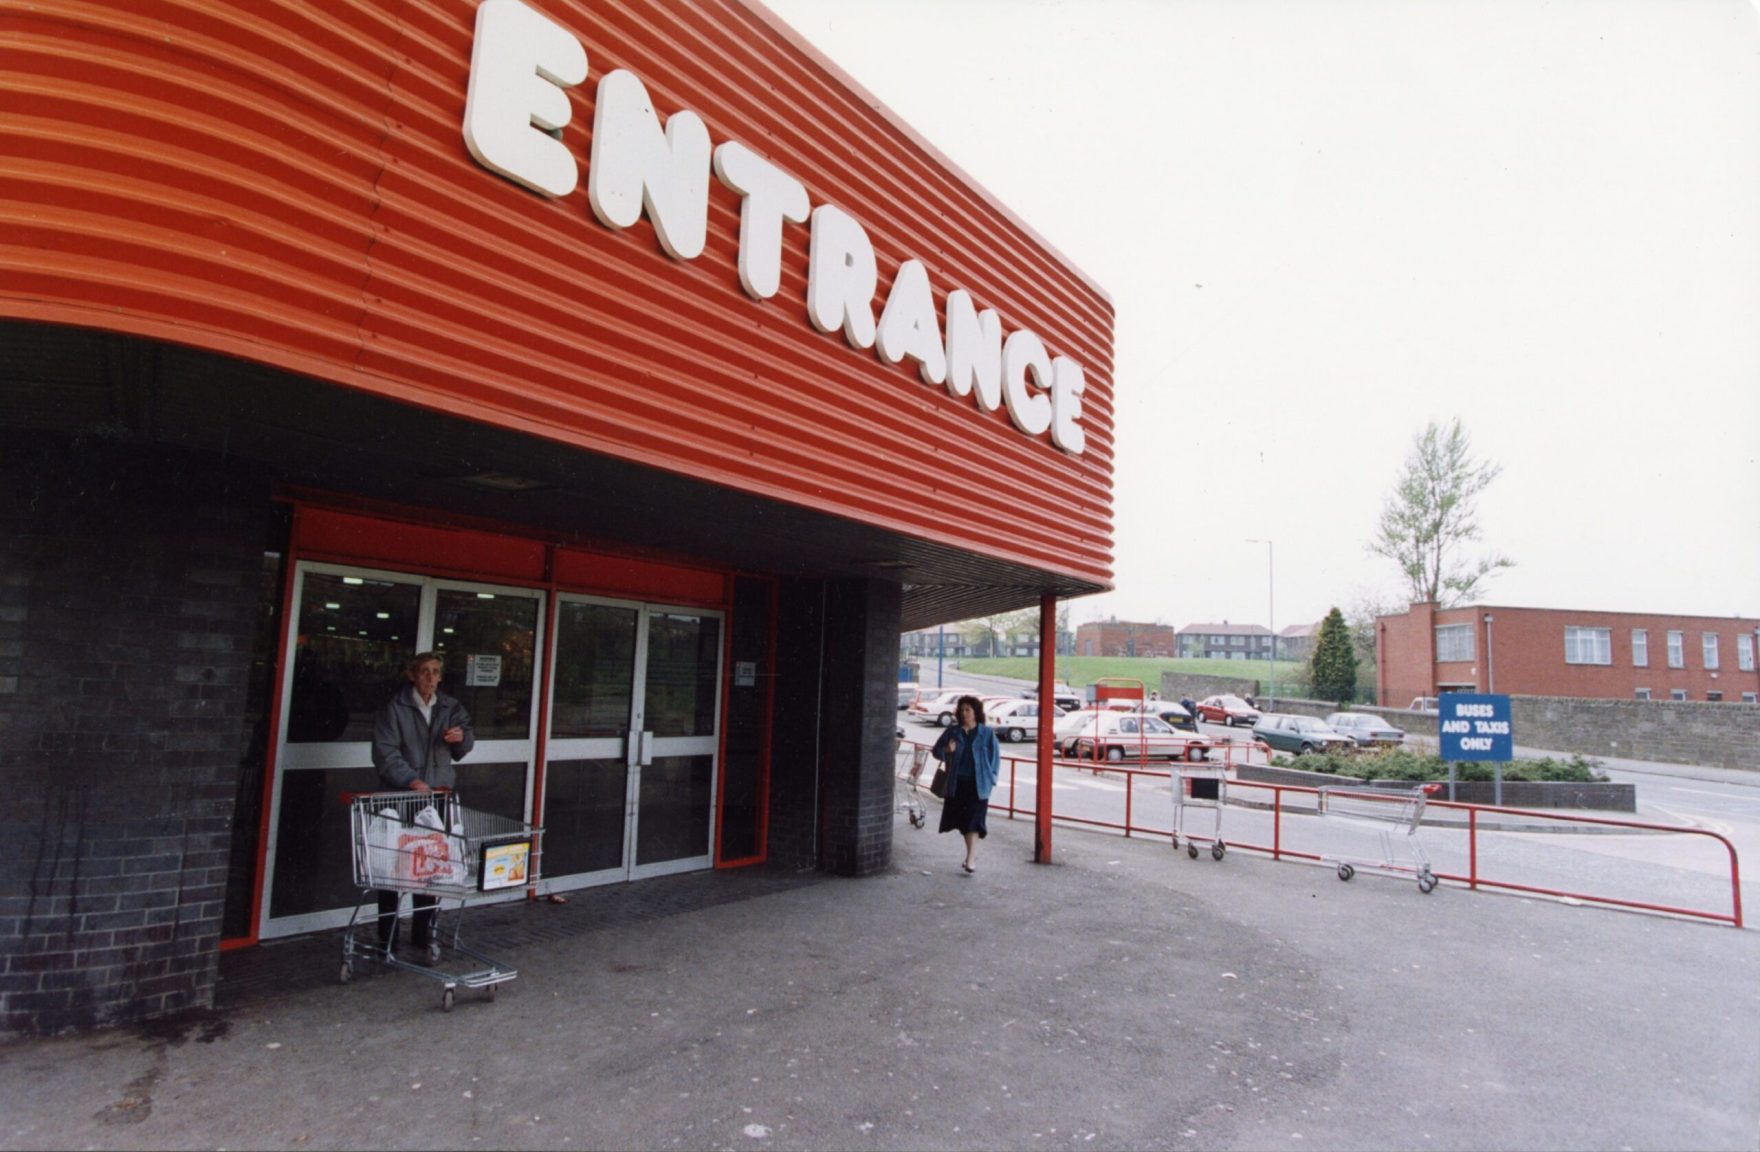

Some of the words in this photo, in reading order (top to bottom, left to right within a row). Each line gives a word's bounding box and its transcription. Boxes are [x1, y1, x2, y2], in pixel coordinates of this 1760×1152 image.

[463, 0, 1086, 455] ENTRANCE
[1456, 704, 1494, 717] BUSES
[1442, 720, 1470, 733] AND
[1474, 721, 1510, 734] TAXIS
[1460, 737, 1493, 750] ONLY
